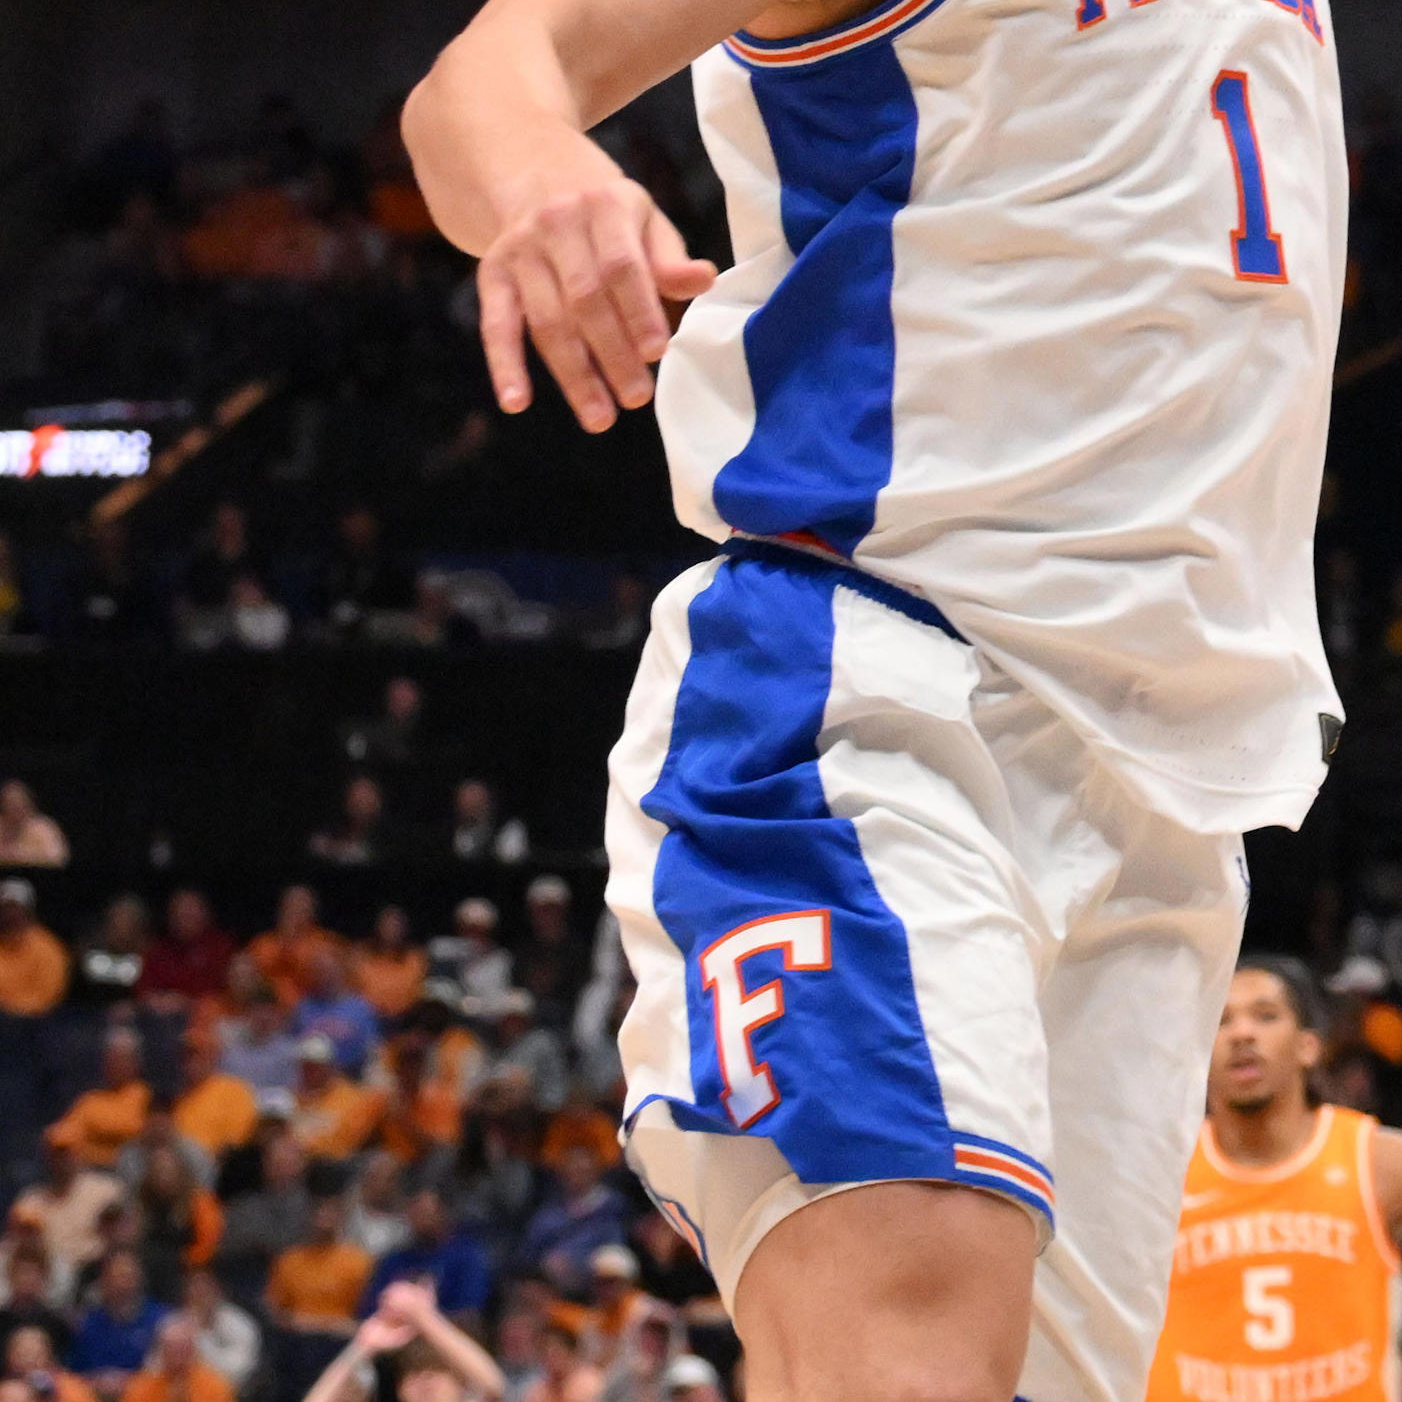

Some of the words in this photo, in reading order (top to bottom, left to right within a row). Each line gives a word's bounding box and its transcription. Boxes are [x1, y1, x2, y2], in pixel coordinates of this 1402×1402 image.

[1210, 68, 1289, 285] 1
[700, 909, 832, 1129] F
[1174, 1210, 1359, 1275] TENNESSEE
[1241, 1265, 1295, 1352] 5
